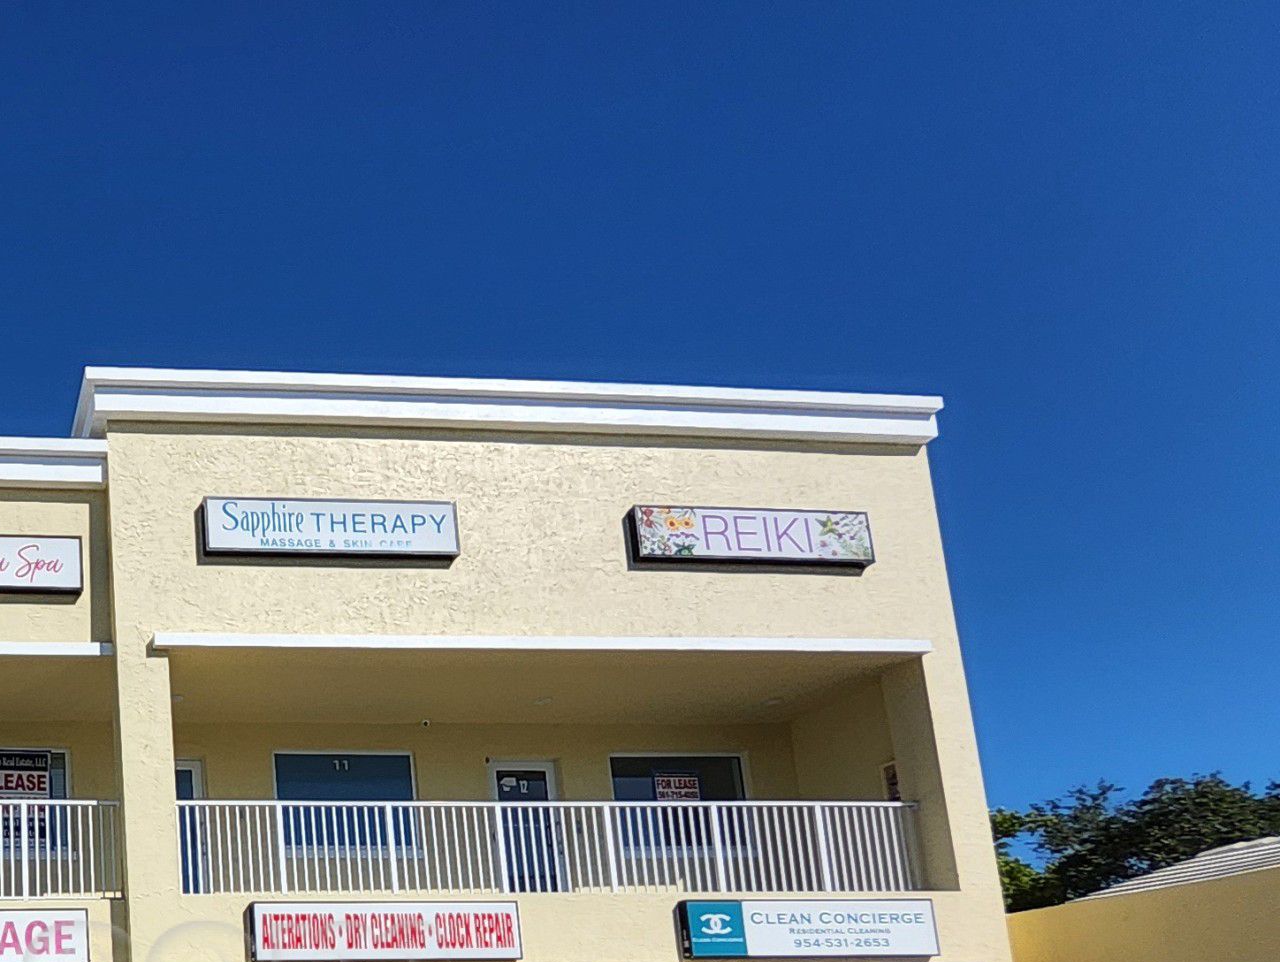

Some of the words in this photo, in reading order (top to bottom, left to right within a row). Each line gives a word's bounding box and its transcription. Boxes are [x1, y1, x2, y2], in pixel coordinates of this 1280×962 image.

[221, 501, 304, 538] Sapphire
[310, 512, 447, 534] THERAPY
[701, 514, 814, 553] REIKI
[260, 537, 322, 548] MASSAGE
[329, 539, 336, 548] &
[15, 544, 64, 583] Spa
[673, 778, 698, 789] LEASE
[750, 911, 812, 925] CLEAN
[819, 911, 926, 925] CONCIERGE
[262, 912, 337, 950] ALTERATIONS
[345, 912, 368, 950] DRY
[370, 912, 426, 950] CLEANING
[434, 912, 473, 949] CLOCK
[474, 911, 516, 949] REPAIR
[789, 927, 845, 935] RESIDENTIAL
[793, 938, 891, 948] 954-531-2653
